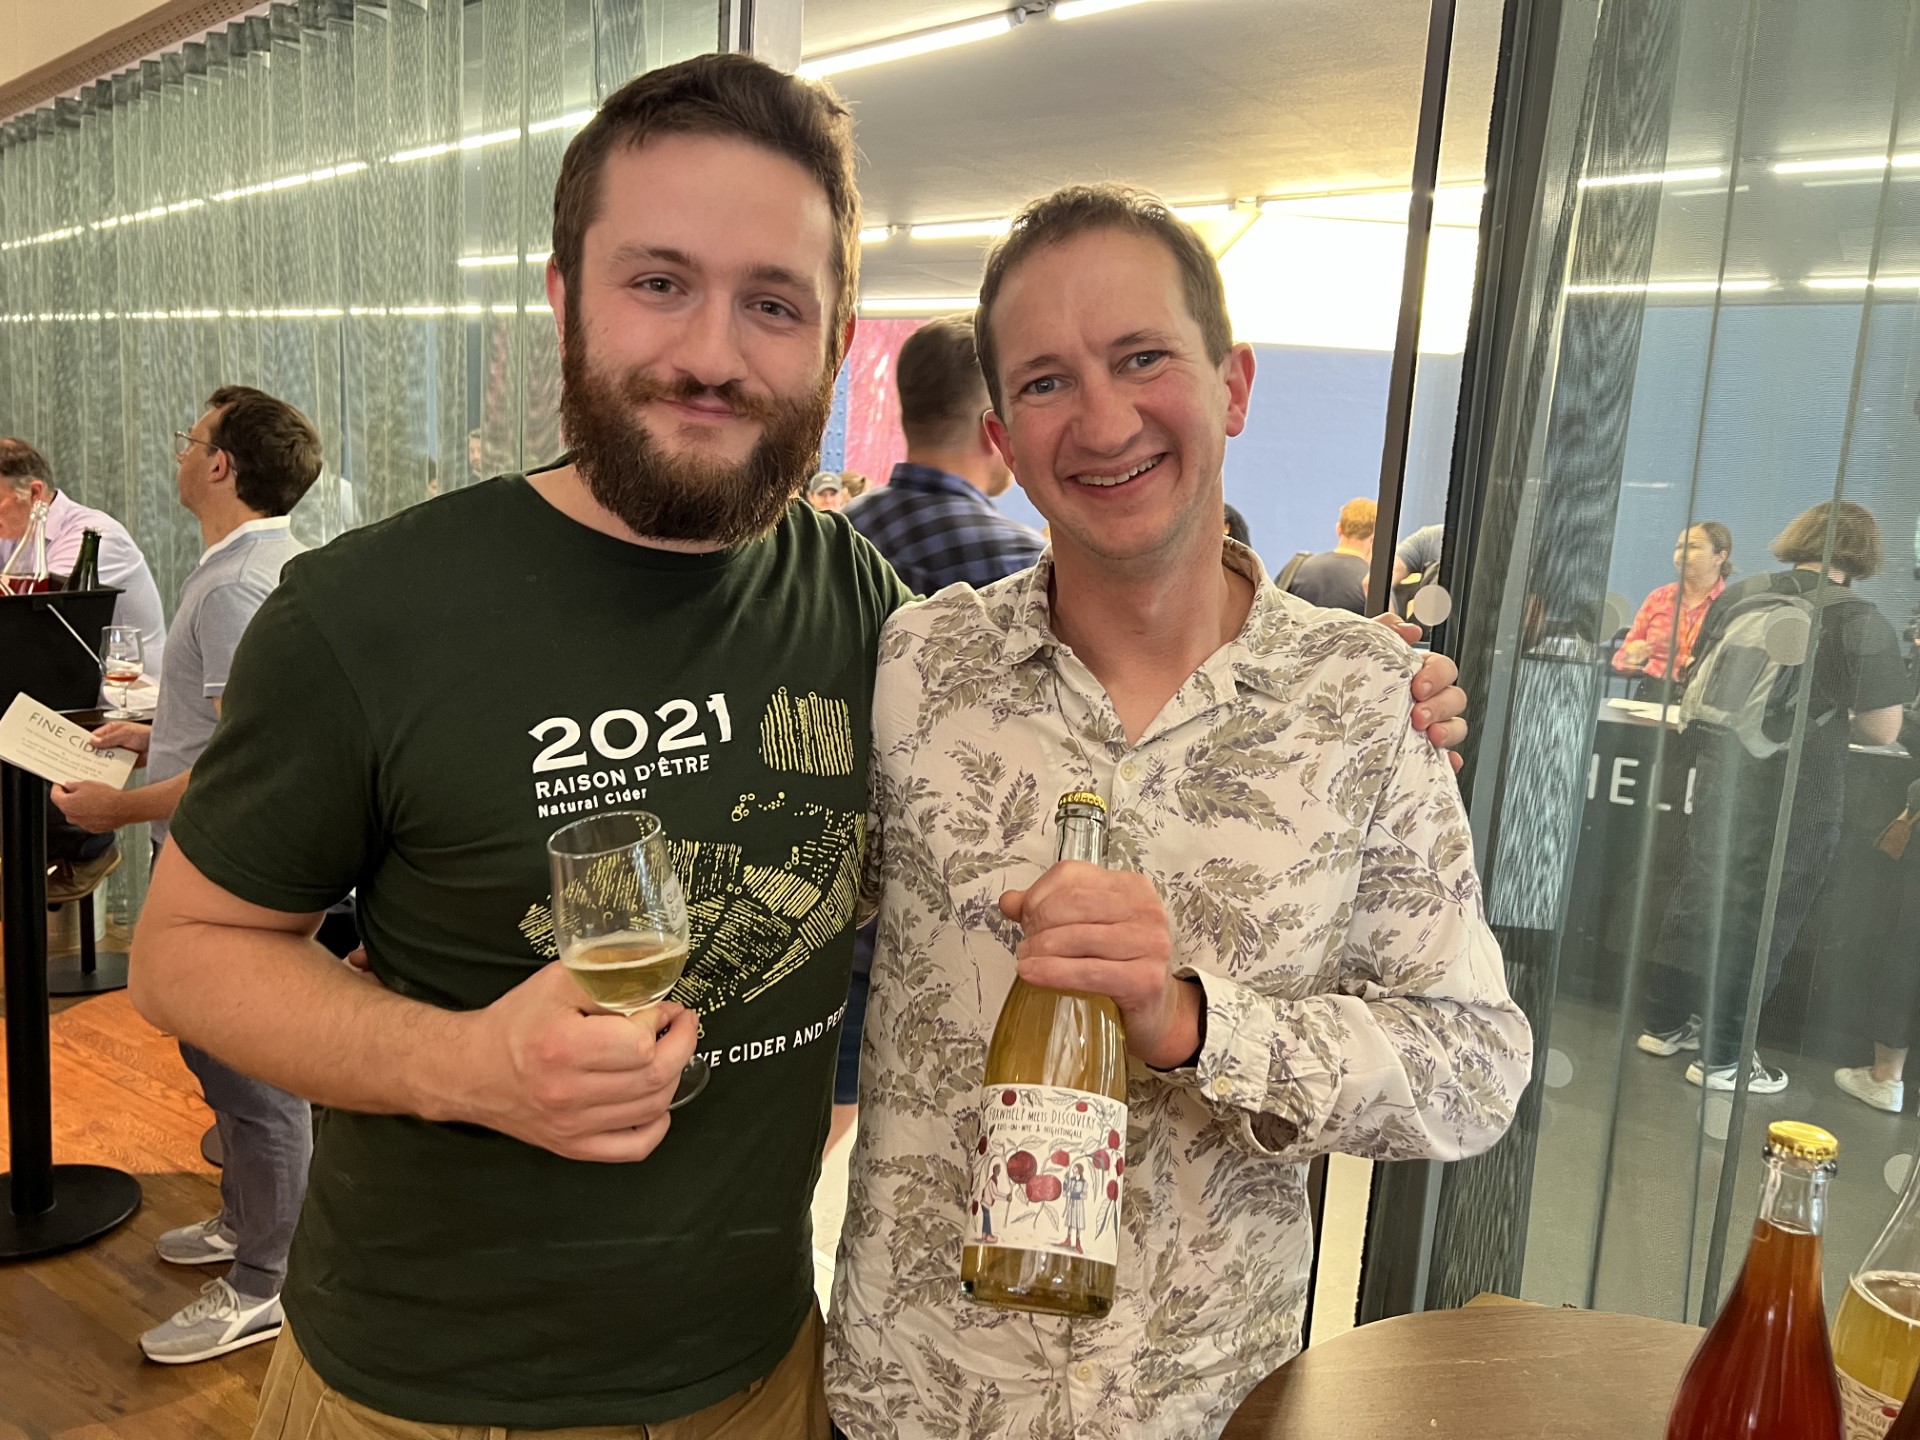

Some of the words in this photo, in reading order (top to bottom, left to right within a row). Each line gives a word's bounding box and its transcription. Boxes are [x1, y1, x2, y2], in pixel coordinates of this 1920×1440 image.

[29, 712, 66, 738] FINE
[528, 693, 732, 774] 2021
[535, 768, 627, 799] RAISON
[538, 795, 599, 818] Natural
[605, 787, 648, 805] Cider
[728, 1035, 787, 1063] CIDER
[793, 1022, 824, 1048] AND
[988, 1106, 1026, 1121] FOXWHELP
[1028, 1110, 1048, 1123] MEETS
[1051, 1109, 1097, 1131] DISCOVERY
[1044, 1125, 1083, 1139] NIGHTINGALE
